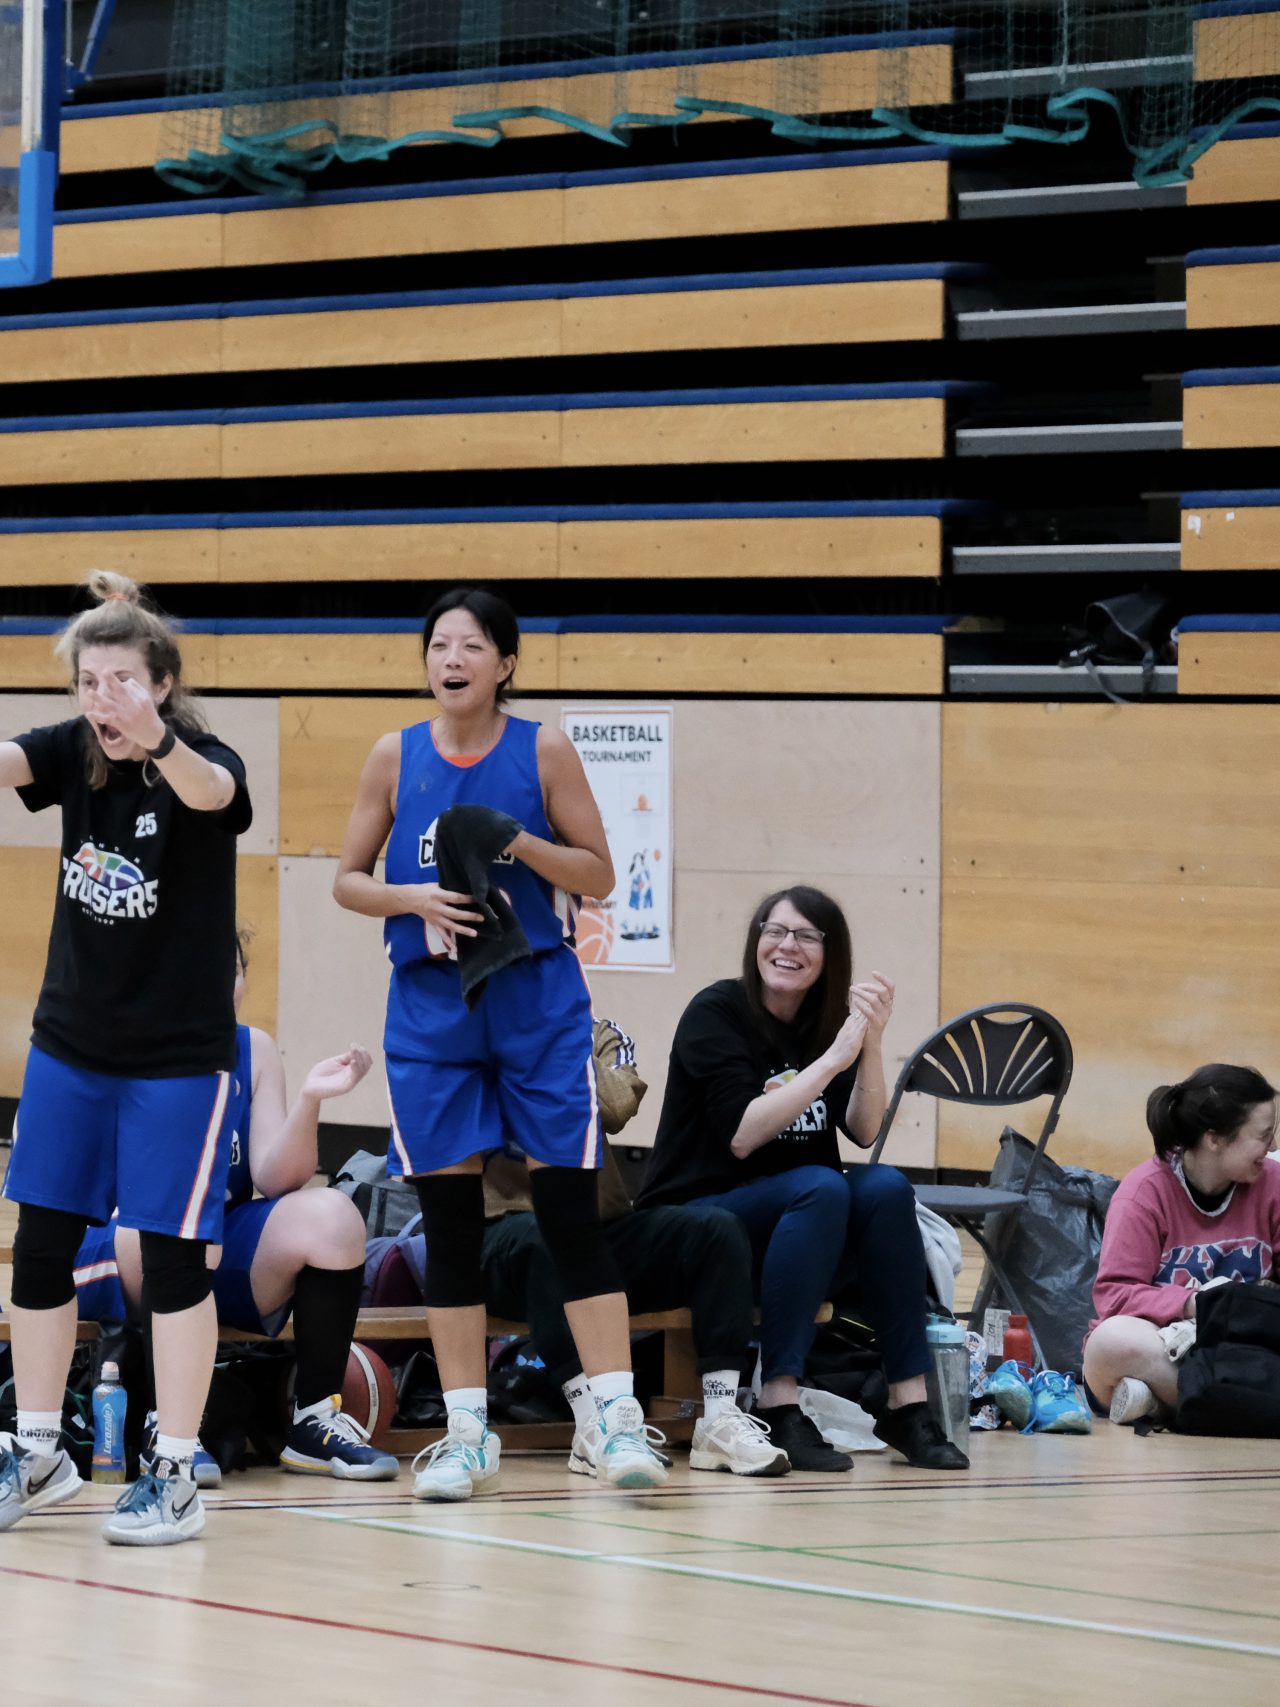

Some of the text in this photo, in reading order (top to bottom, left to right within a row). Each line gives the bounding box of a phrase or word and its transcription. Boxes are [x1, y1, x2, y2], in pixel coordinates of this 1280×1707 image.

[573, 725, 663, 743] BASKETBALL
[582, 751, 652, 763] TOURNAMENT
[135, 812, 157, 838] 25
